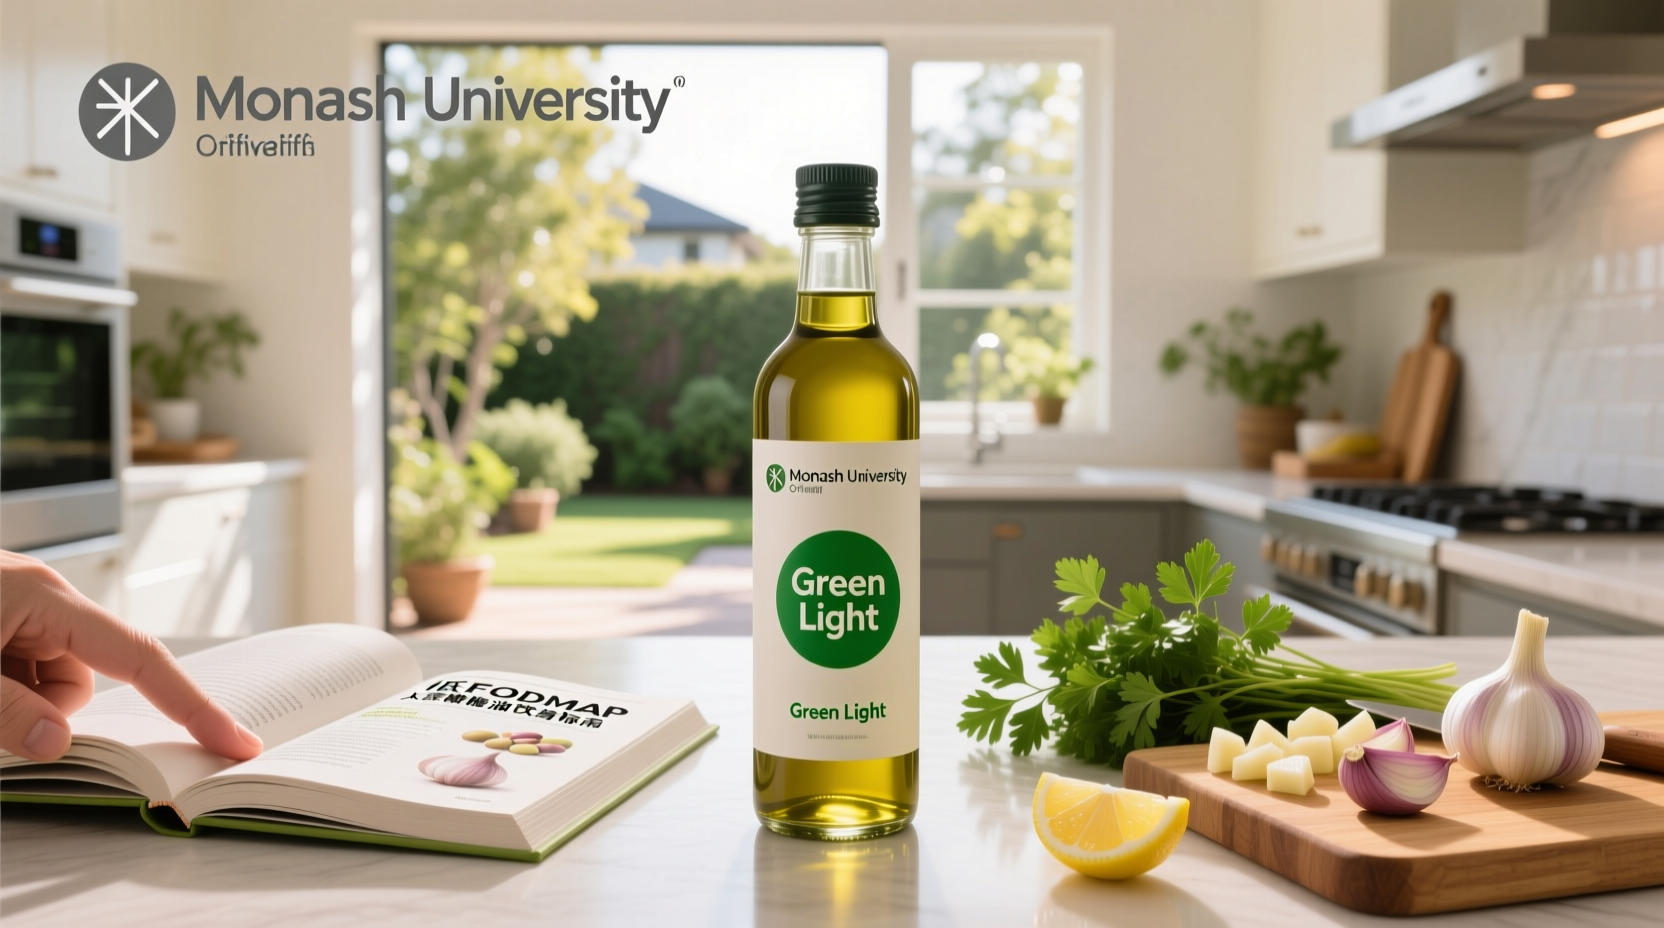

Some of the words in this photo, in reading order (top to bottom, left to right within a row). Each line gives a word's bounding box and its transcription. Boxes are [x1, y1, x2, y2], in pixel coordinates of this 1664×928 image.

[790, 469, 844, 483] Monash
[847, 468, 907, 486] University
[791, 566, 886, 597] Green
[799, 601, 879, 640] Light
[790, 702, 839, 720] Green
[844, 701, 887, 724] Light
